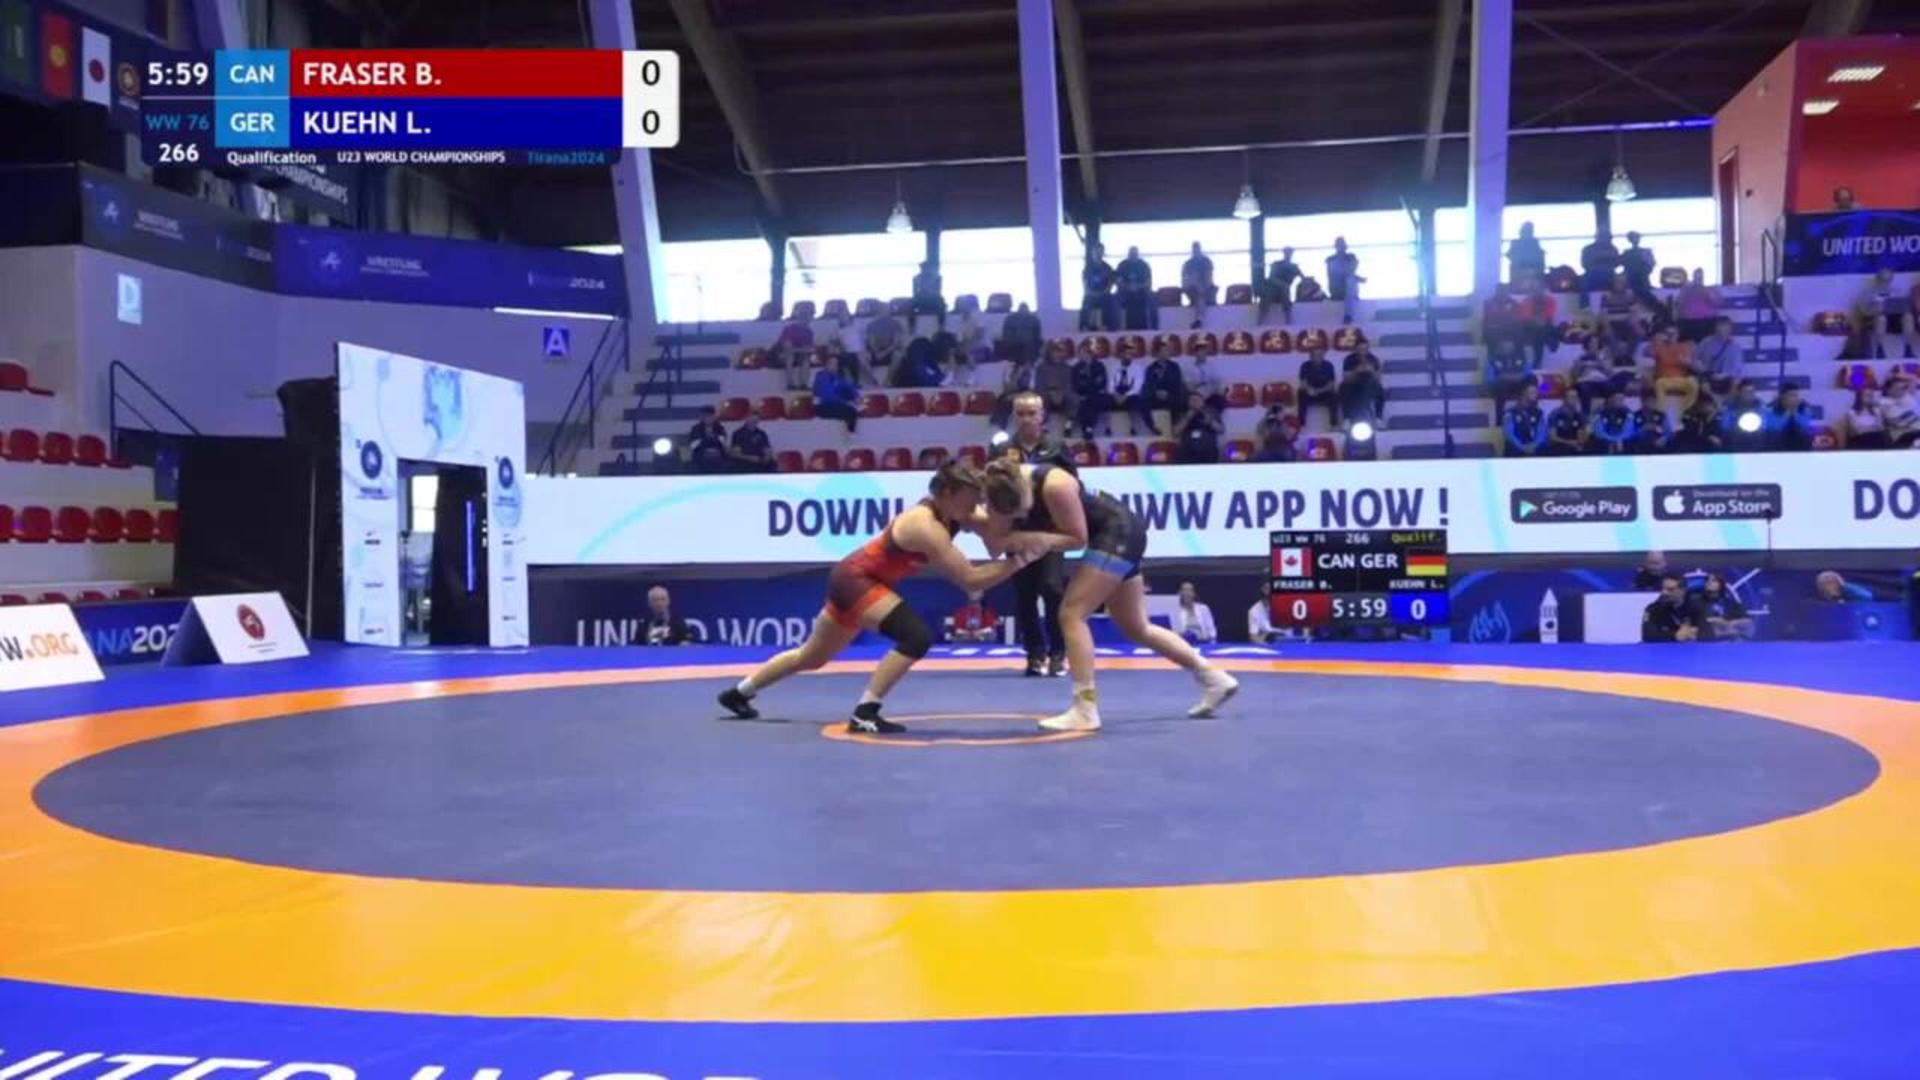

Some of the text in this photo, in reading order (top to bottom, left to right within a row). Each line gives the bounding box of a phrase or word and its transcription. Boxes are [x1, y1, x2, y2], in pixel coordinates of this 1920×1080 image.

[1823, 236, 1887, 257] UNITED
[545, 330, 568, 355] A
[1224, 489, 1306, 529] APP
[1320, 487, 1424, 528] NOW
[1542, 498, 1631, 519] Google Play
[1692, 498, 1771, 516] App Store
[1853, 478, 1920, 520] DO
[1345, 533, 1370, 545] 266
[1318, 553, 1356, 569] CAN
[1360, 553, 1399, 569] GER
[1273, 580, 1314, 590] FRASER
[1389, 580, 1426, 590] KUEHN
[1292, 599, 1308, 621] 0
[1332, 598, 1388, 618] 5:59
[1410, 598, 1427, 621] 0
